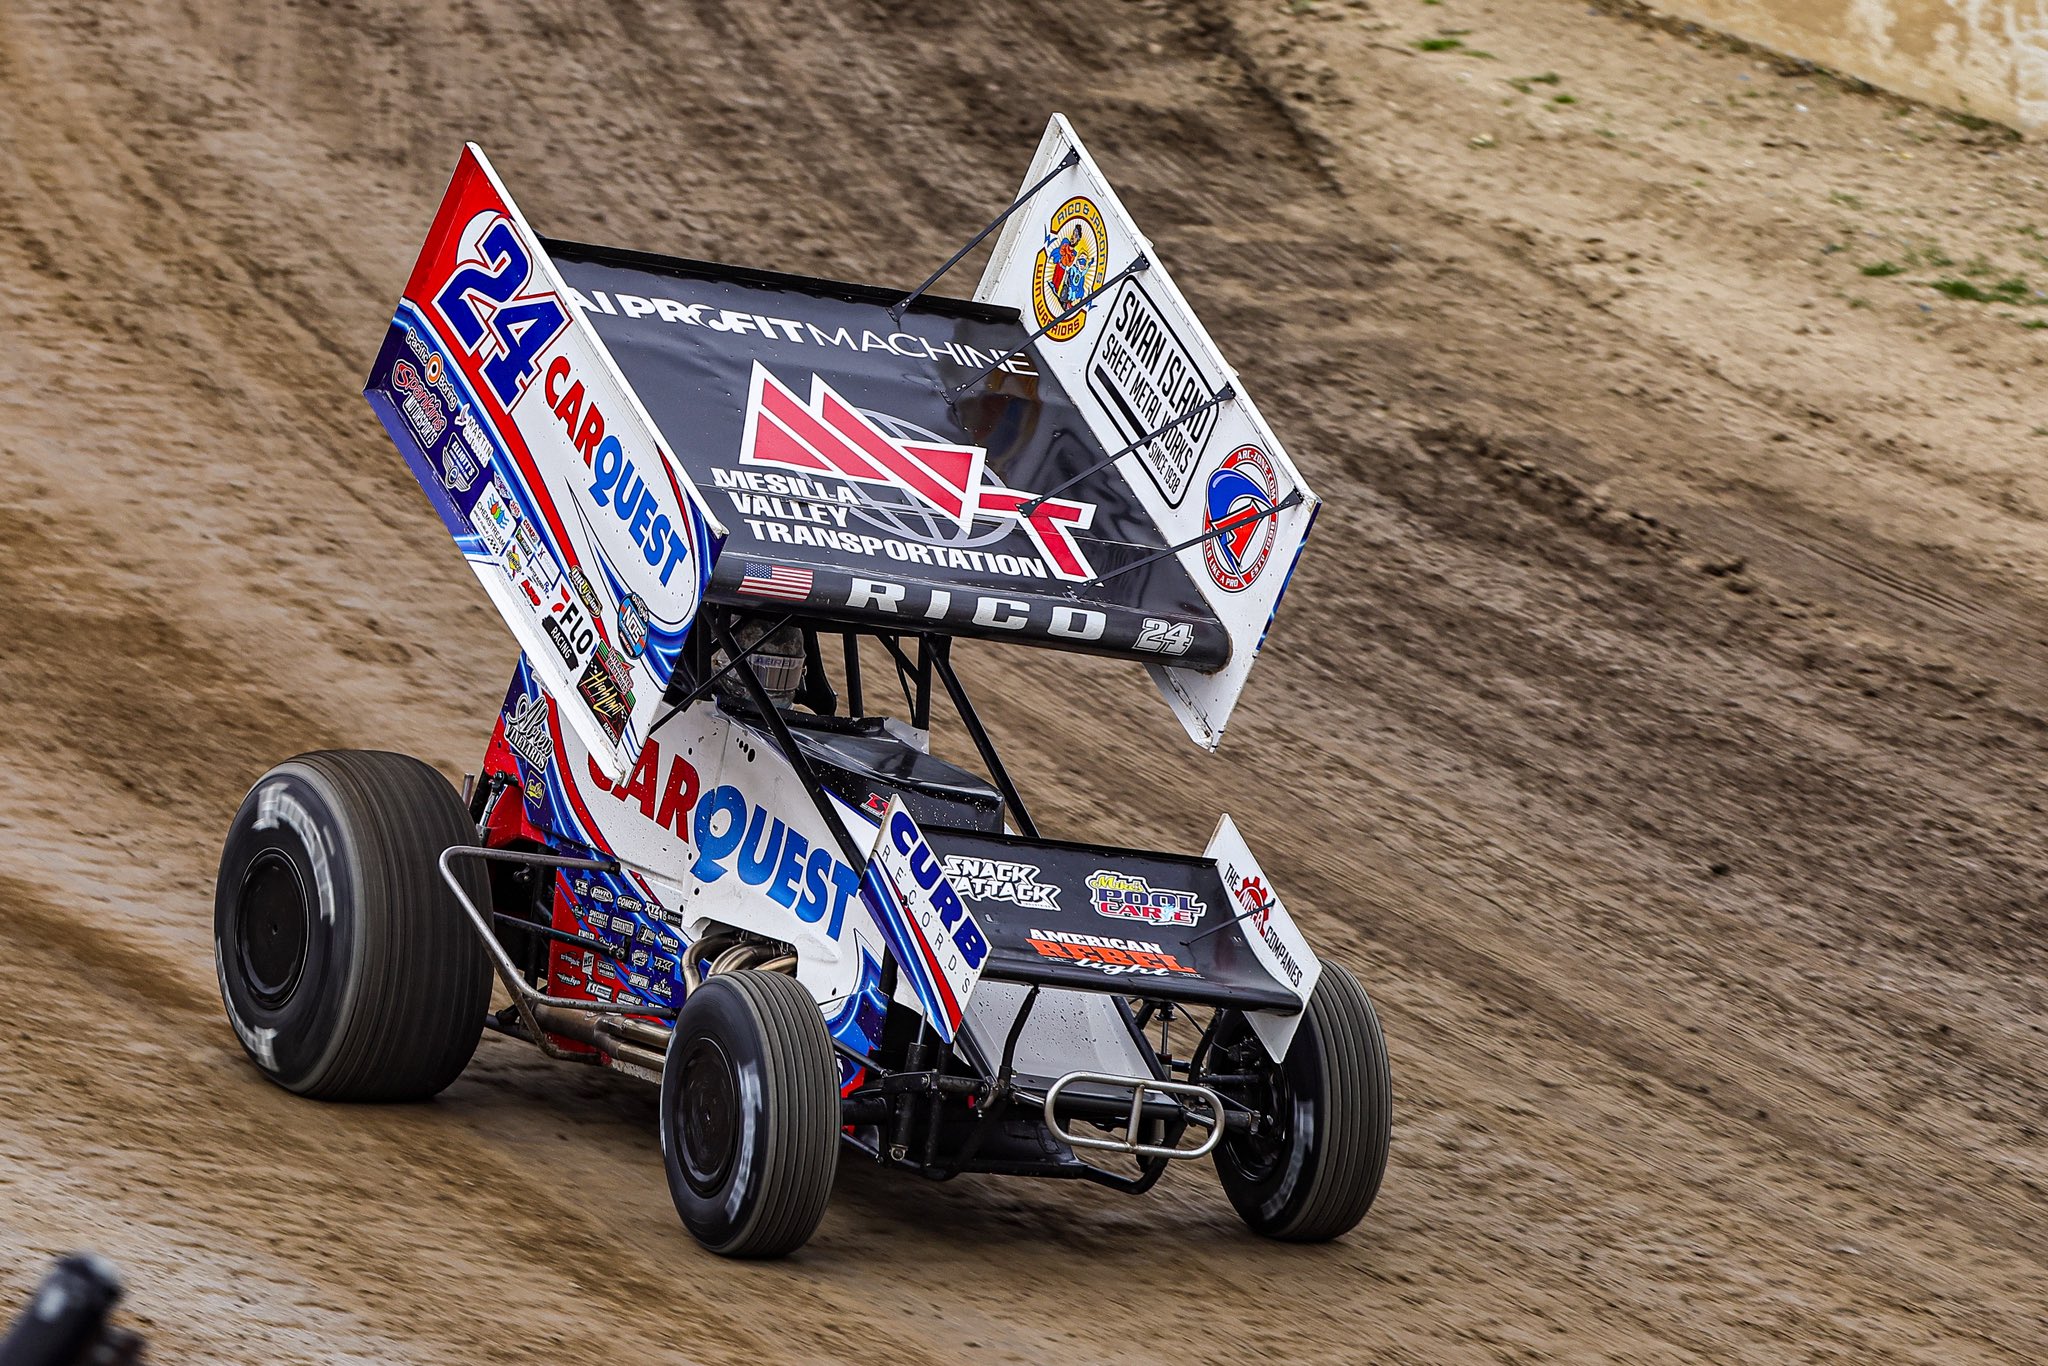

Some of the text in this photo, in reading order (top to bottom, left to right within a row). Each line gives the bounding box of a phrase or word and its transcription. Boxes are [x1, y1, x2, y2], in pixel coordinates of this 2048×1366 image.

[1057, 202, 1081, 225] RICO
[434, 219, 571, 413] 24
[407, 328, 458, 408] Pacific Boring
[1102, 333, 1137, 387] SHEET
[1129, 370, 1163, 429] METAL
[1115, 290, 1211, 444] SWAN ISLAND
[404, 394, 438, 445] MOTORSPORTS
[467, 417, 493, 458] MARTIN
[451, 440, 476, 477] ELLIOTT'S
[545, 355, 688, 588] CARQUEST
[1148, 441, 1181, 495] SINCE 1938
[711, 467, 861, 506] MESILLA
[476, 501, 507, 548] CHEMSTREAM
[729, 491, 852, 529] VALLEY
[744, 518, 1049, 579] TRANSPORTATION
[1208, 557, 1221, 580] LIKE
[1225, 577, 1239, 587] PRO
[622, 605, 645, 643] NOS
[845, 577, 1107, 641] RICO
[550, 626, 571, 659] RACING
[1131, 617, 1195, 656] 24
[607, 661, 630, 692] BATTERIES
[610, 652, 633, 687] INTERSTATE
[505, 724, 548, 772] VINEYARDS
[602, 722, 619, 746] RACING
[890, 810, 988, 971] CURB
[944, 857, 1033, 885] SNACK
[1223, 862, 1240, 892] THE
[882, 843, 971, 994] RECORDS
[1098, 888, 1201, 914] POOL
[1100, 901, 1192, 923] CARE
[1024, 937, 1198, 974] REBEL
[1029, 928, 1165, 955] AMERICAN
[1263, 925, 1304, 988] COMPANIES
